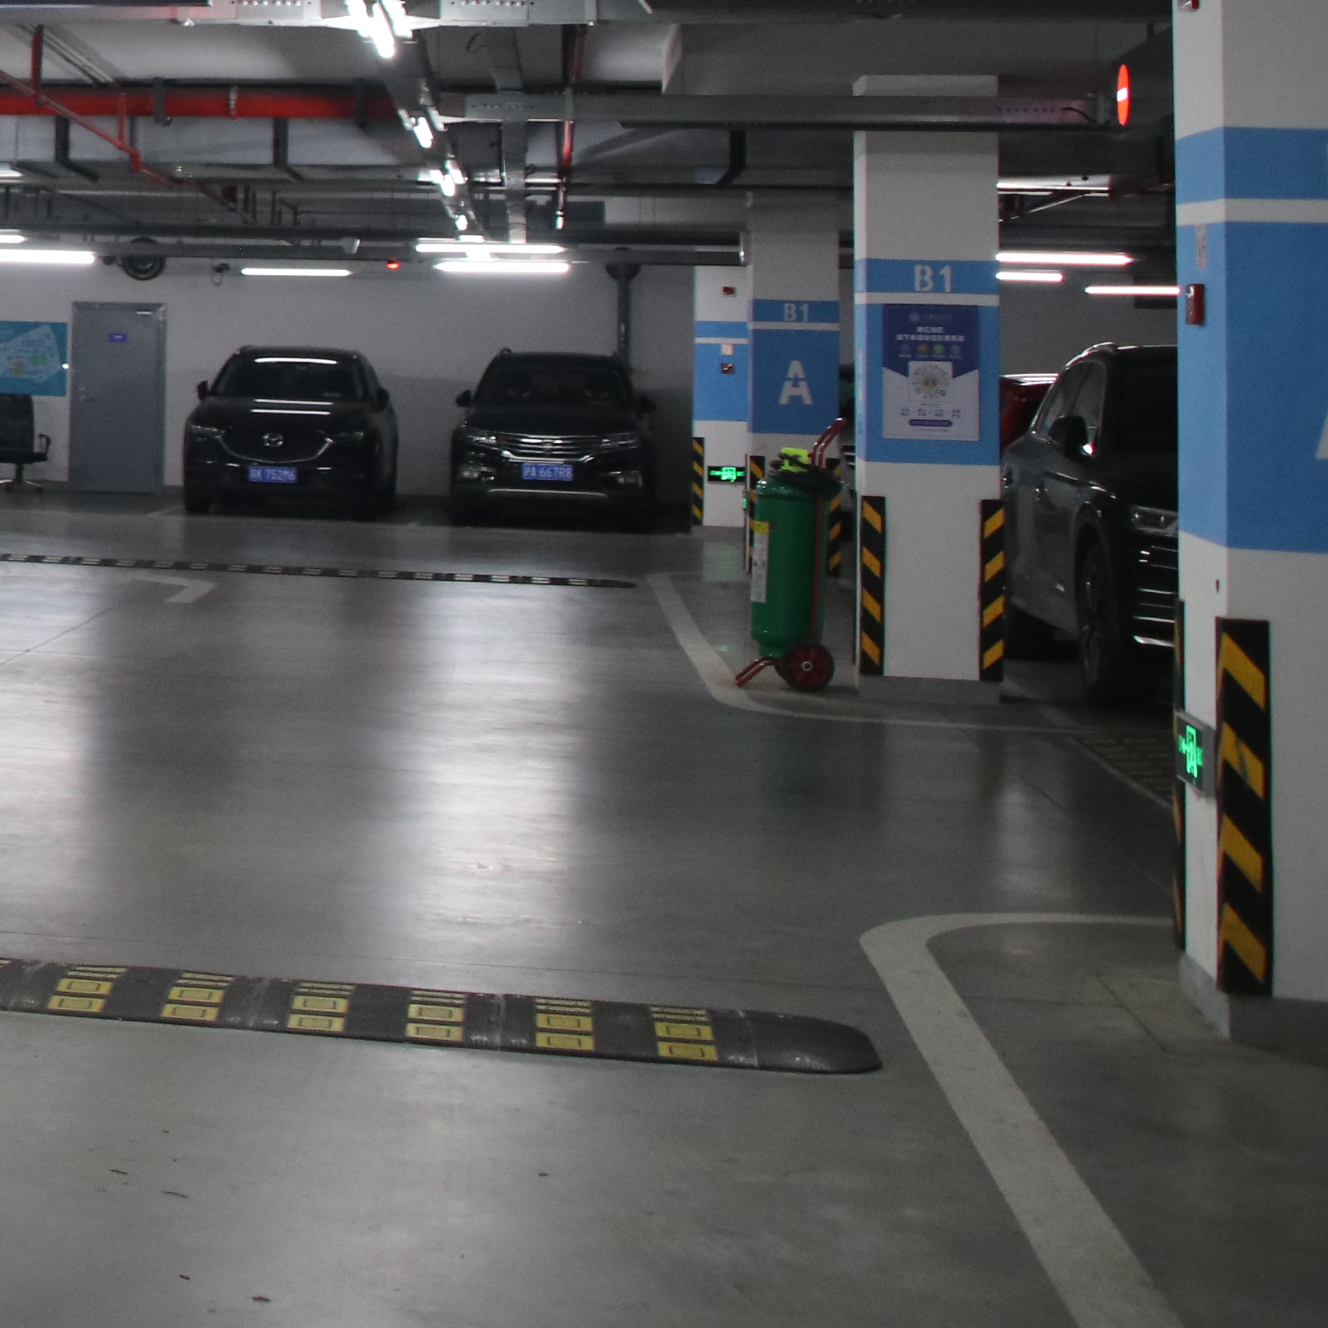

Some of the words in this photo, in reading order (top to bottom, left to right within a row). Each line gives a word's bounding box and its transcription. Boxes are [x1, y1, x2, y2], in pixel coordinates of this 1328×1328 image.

[913, 264, 953, 292] B1
[783, 303, 810, 322] B1
[779, 360, 813, 406] A
